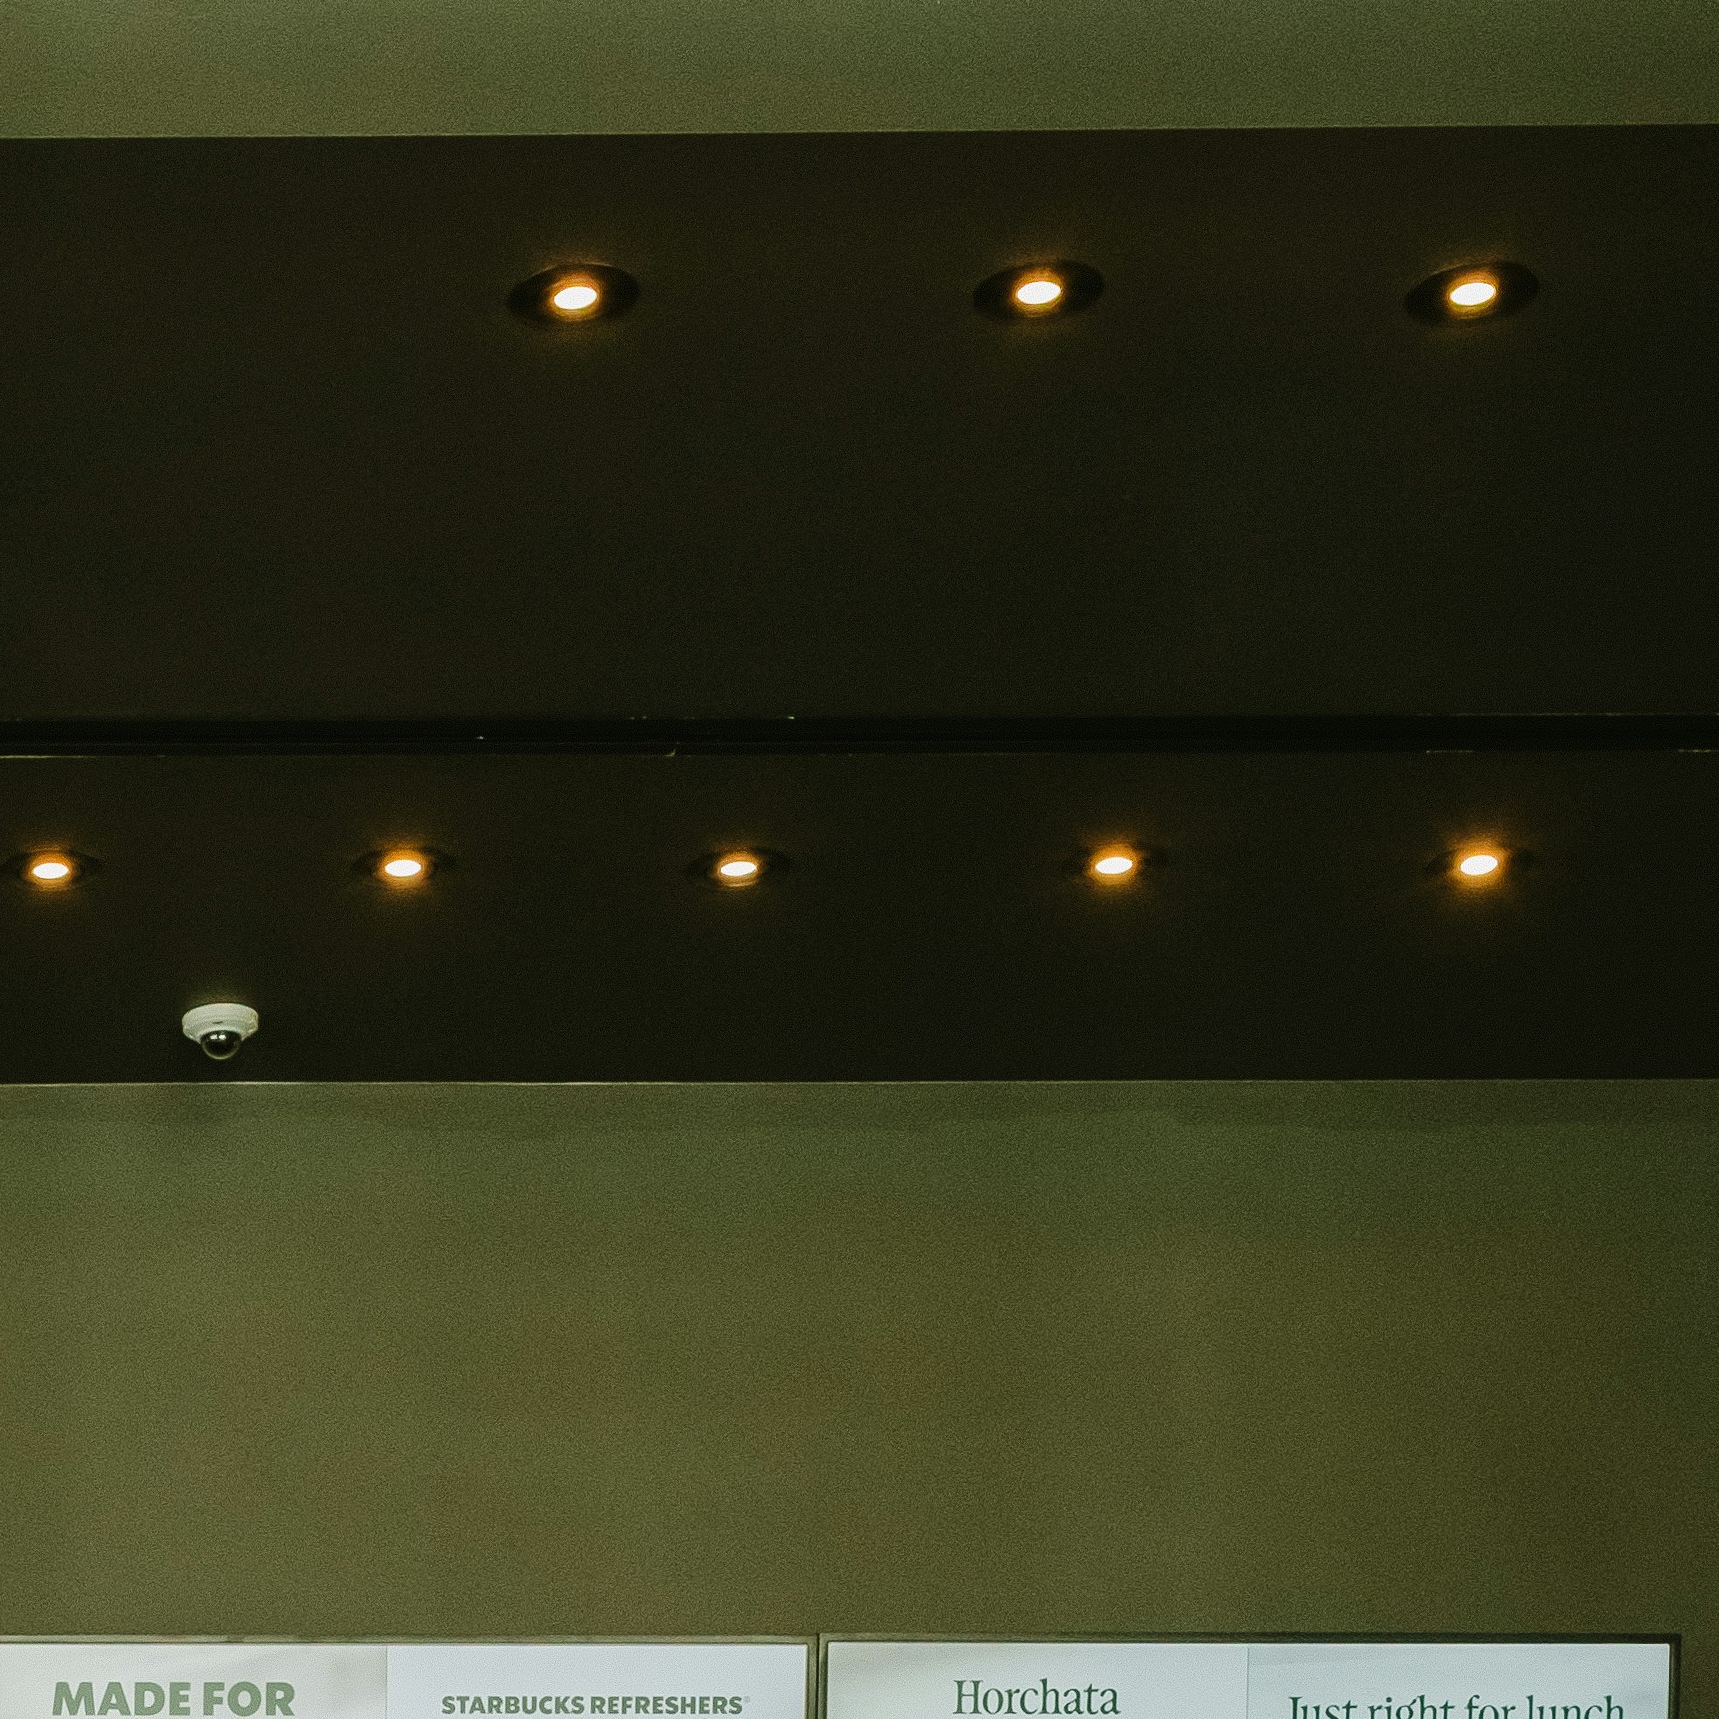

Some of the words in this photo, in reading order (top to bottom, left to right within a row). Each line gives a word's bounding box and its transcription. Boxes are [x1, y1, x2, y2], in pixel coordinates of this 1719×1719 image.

[52, 1682, 191, 1716] MADE
[203, 1681, 295, 1717] FOR
[442, 1696, 584, 1714] STARBUCKS
[954, 1678, 1120, 1715] Horchata
